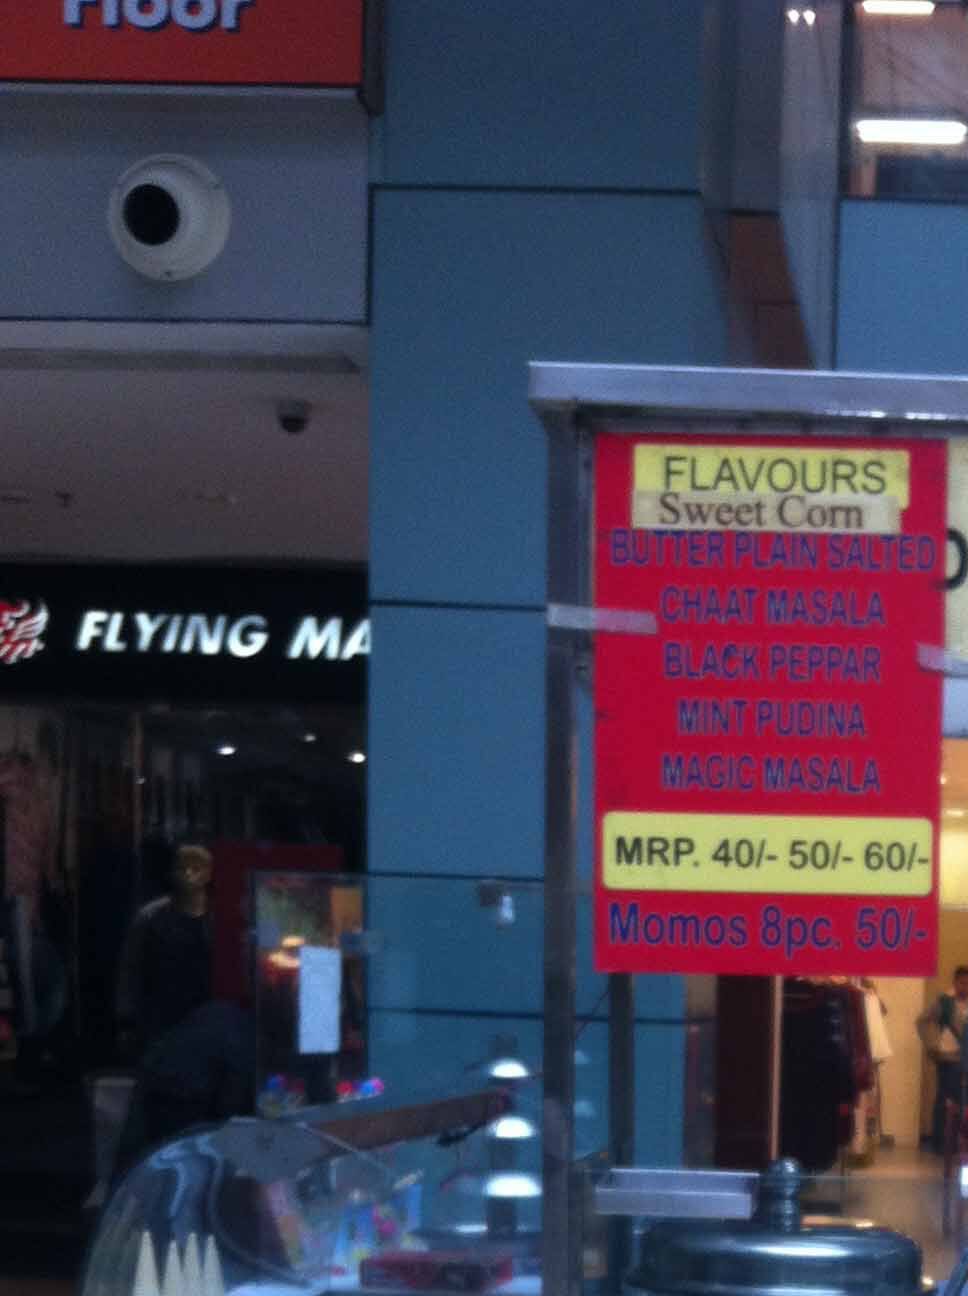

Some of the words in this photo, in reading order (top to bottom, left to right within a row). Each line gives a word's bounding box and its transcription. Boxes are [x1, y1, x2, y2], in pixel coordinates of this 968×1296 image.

[663, 455, 887, 495] FLAVOURS
[659, 492, 766, 528] Sweet
[776, 495, 865, 529] Corn
[610, 529, 726, 568] BUTTER
[734, 531, 819, 570] PLAIN
[827, 533, 936, 572] SALTED
[660, 586, 758, 625] CHAAT
[767, 588, 886, 628] MASALA
[76, 610, 269, 658] FLYING
[664, 642, 760, 680] BLACK
[769, 644, 882, 684] PEPPAR
[677, 699, 747, 736] MINT
[756, 700, 866, 737] PUDINA
[662, 755, 755, 791] MAGIC
[763, 757, 882, 794] MASALA
[614, 836, 700, 869] MRP.
[711, 837, 778, 870] 40/-
[788, 839, 854, 872] 50/-
[863, 841, 929, 874] 60/-
[609, 902, 747, 947] Momos
[761, 904, 842, 959] 8pc.
[856, 906, 927, 951] 50/-
